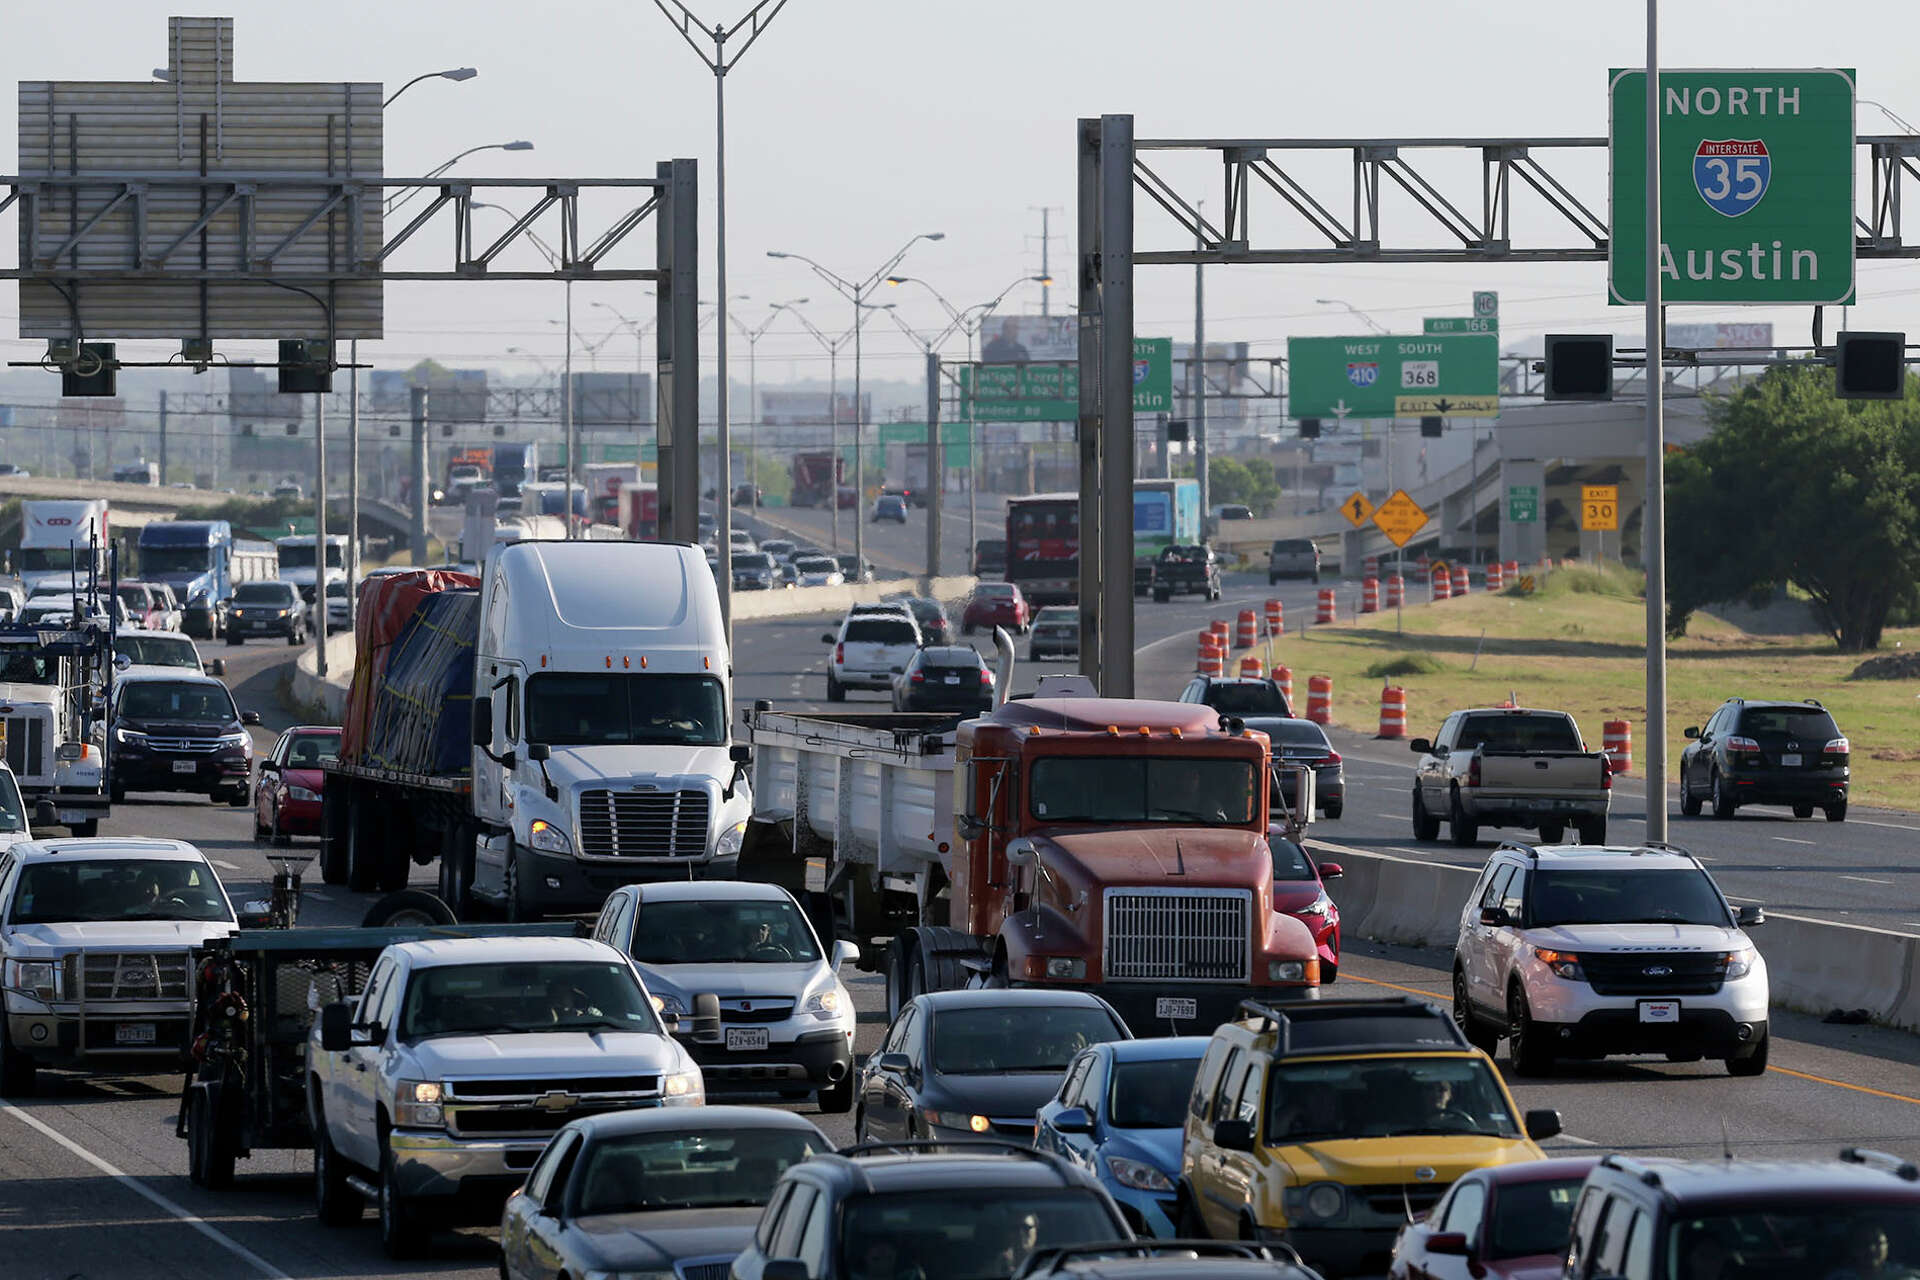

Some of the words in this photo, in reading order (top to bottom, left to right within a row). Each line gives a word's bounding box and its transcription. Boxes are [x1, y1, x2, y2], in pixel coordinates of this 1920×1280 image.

[1666, 87, 1801, 116] NORTH
[1705, 144, 1759, 155] INTERSTATE
[1703, 158, 1764, 201] 35
[1660, 240, 1819, 281] Austin
[1432, 321, 1454, 331] EXIT
[1464, 319, 1489, 332] 166
[1344, 344, 1380, 356] WEST
[1397, 342, 1443, 355] SOUTH
[1350, 367, 1377, 384] 410
[1404, 370, 1436, 385] 368
[1399, 401, 1429, 413] EXIT
[1454, 400, 1494, 412] ONLY
[1589, 490, 1609, 498] EXIT
[1587, 504, 1613, 519] 30
